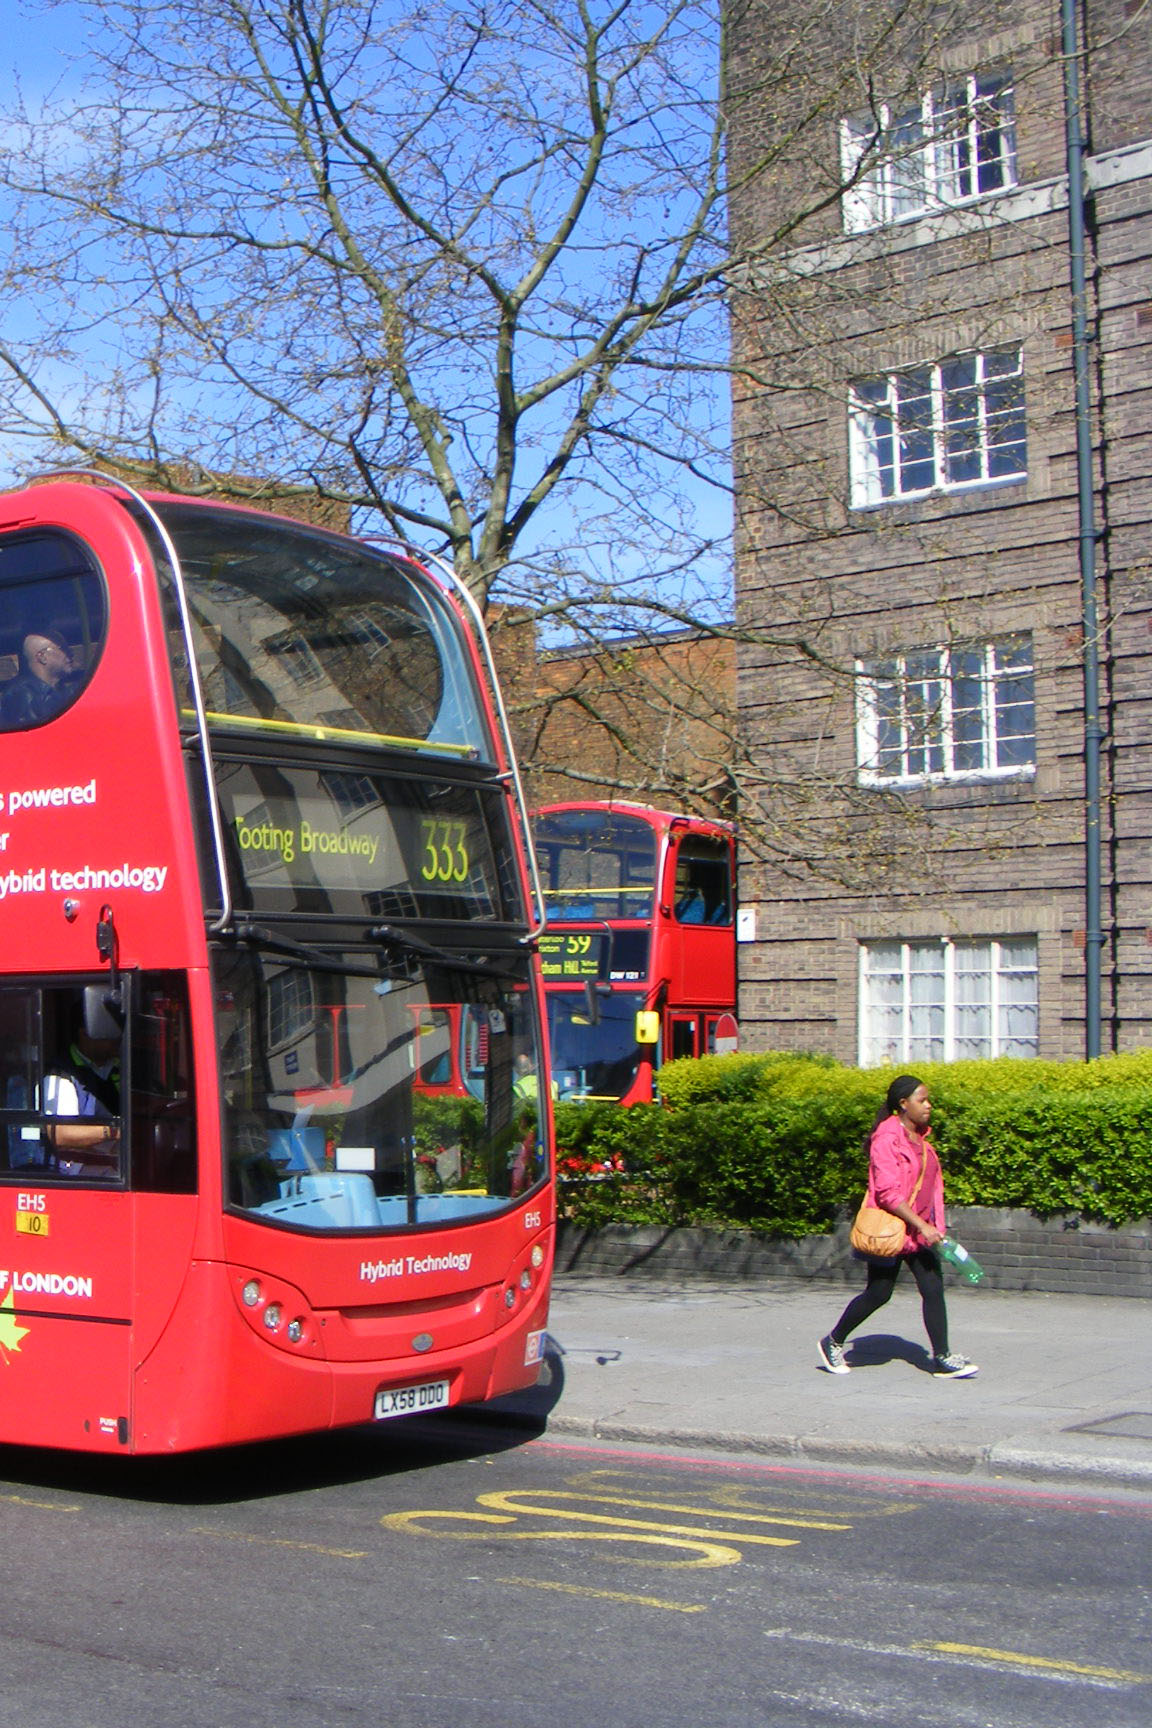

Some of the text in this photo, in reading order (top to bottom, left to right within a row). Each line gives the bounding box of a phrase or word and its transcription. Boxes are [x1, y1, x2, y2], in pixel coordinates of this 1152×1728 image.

[9, 778, 97, 816] powered
[235, 816, 380, 864] Tooting Broadway
[421, 820, 469, 882] 333
[49, 862, 168, 893] technology
[566, 936, 592, 954] 59
[17, 1193, 47, 1212] EH5
[28, 1216, 42, 1233] 10
[525, 1211, 542, 1230] EH5
[360, 1251, 472, 1283] Hybrid Technology
[12, 1271, 93, 1298] LONDON
[381, 1383, 444, 1413] LX58 DDO
